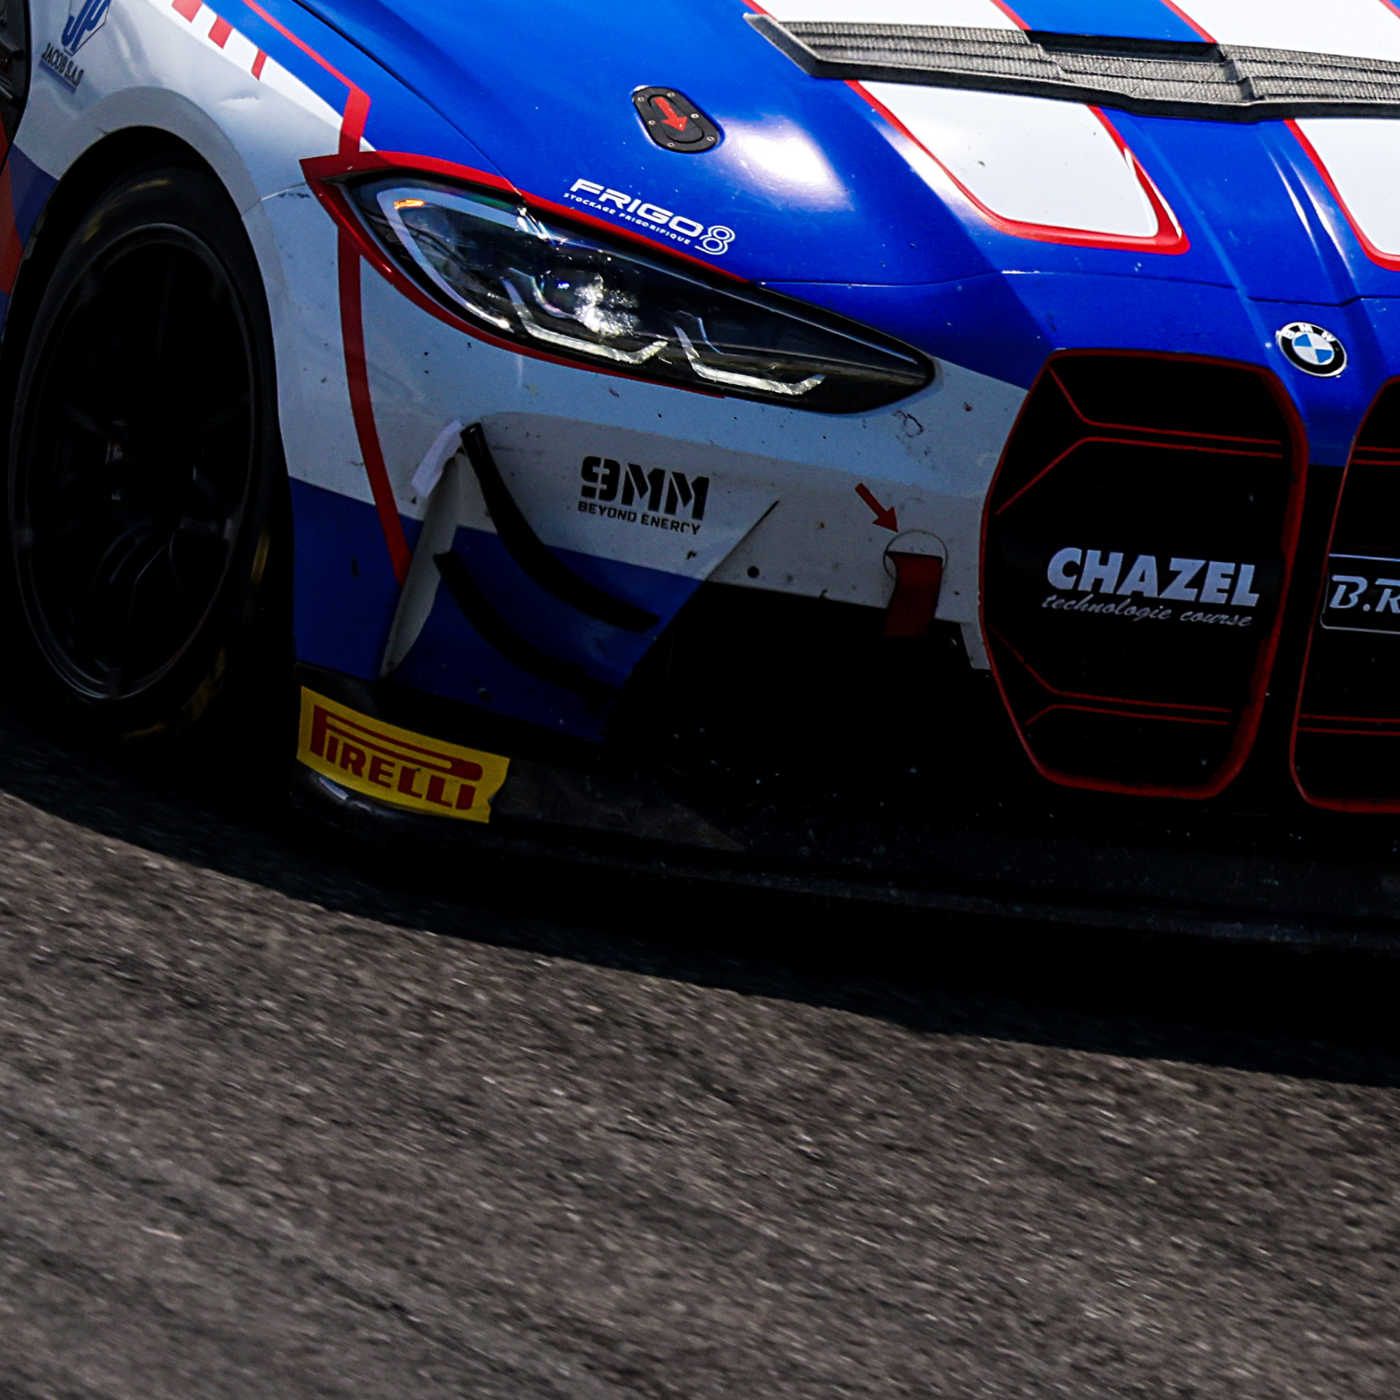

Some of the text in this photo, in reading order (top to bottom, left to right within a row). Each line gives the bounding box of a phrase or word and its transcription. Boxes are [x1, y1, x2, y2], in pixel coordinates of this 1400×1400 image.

[563, 192, 691, 245] STOCKAGE FRIGORIFIQUE
[581, 455, 710, 521] 9MM
[578, 501, 701, 535] BEYOND ENERGY
[1047, 547, 1259, 607] CHAZEL
[1041, 593, 1252, 627] technologie course
[309, 705, 483, 810] PIRELLI
